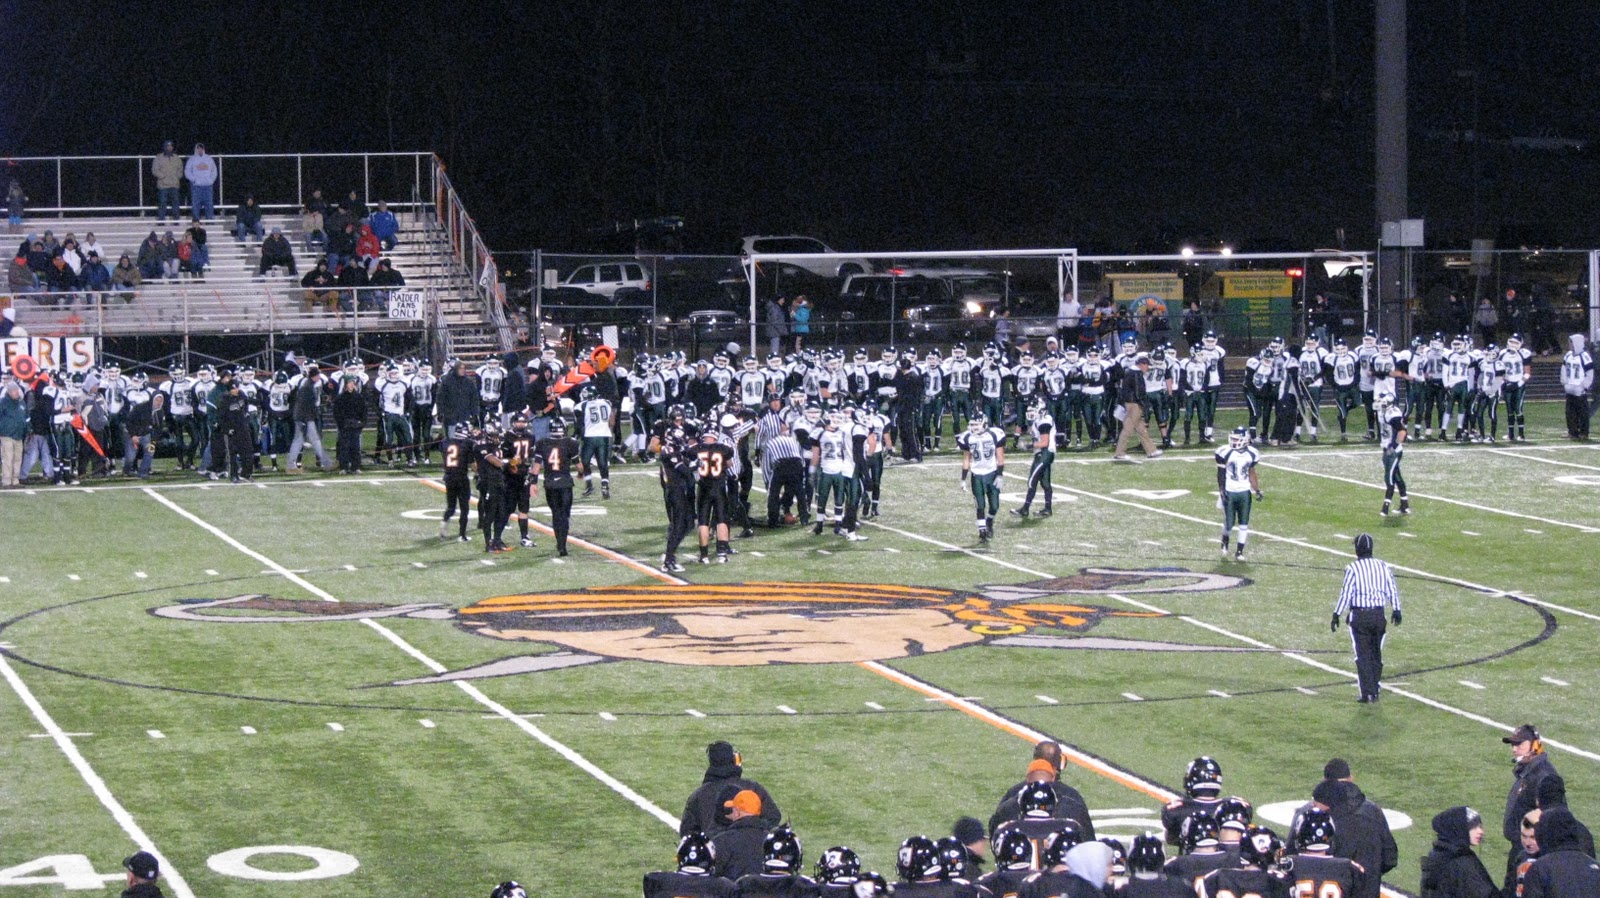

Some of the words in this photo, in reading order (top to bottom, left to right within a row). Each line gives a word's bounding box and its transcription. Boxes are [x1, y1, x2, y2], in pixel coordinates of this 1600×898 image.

[390, 291, 420, 303] RAIDER
[391, 308, 418, 318] ONLY
[589, 405, 609, 424] 50
[446, 444, 459, 467] 2
[513, 440, 529, 460] 77
[548, 447, 561, 471] 4
[697, 451, 723, 477] 53
